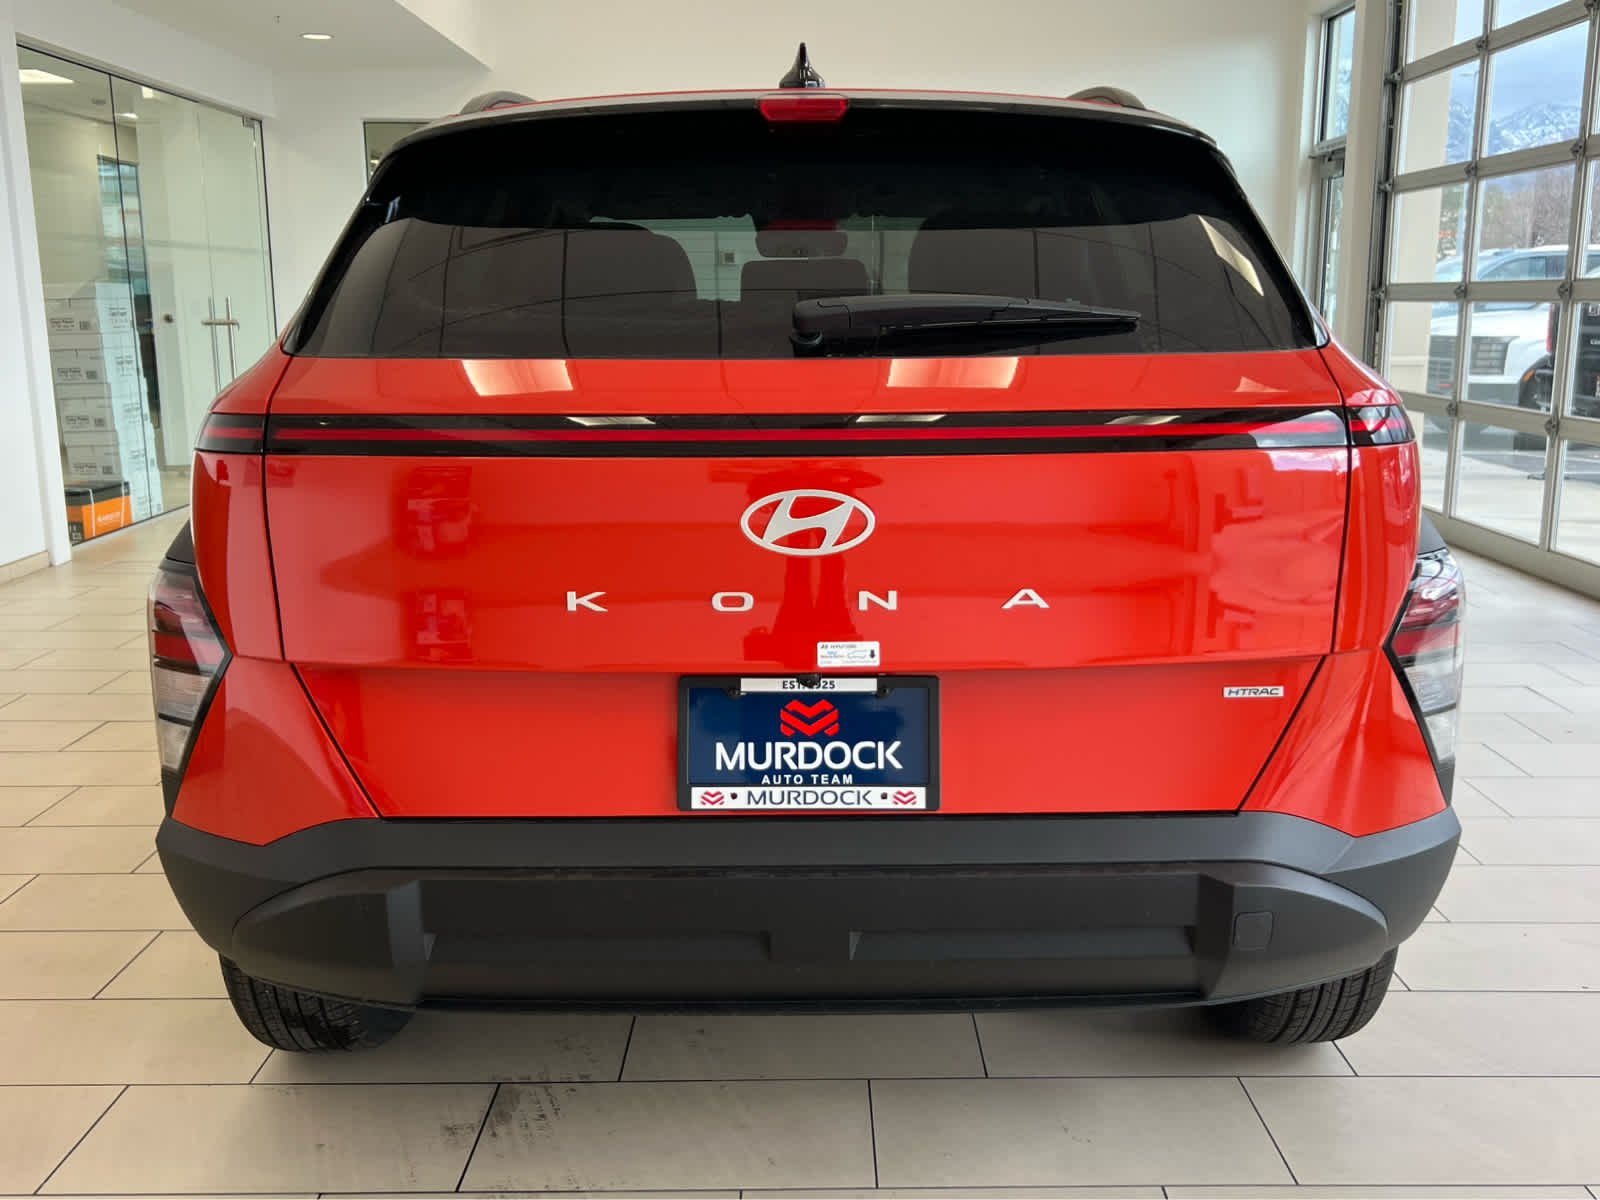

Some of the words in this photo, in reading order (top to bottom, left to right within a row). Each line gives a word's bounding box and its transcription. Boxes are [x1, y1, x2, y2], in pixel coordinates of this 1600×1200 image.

[566, 588, 1050, 612] KONA
[1228, 687, 1280, 696] HTRAC
[715, 741, 904, 770] MURDOCK
[761, 774, 804, 785] AUTO
[810, 774, 854, 785] TEAM
[747, 790, 873, 806] MURDOCK
